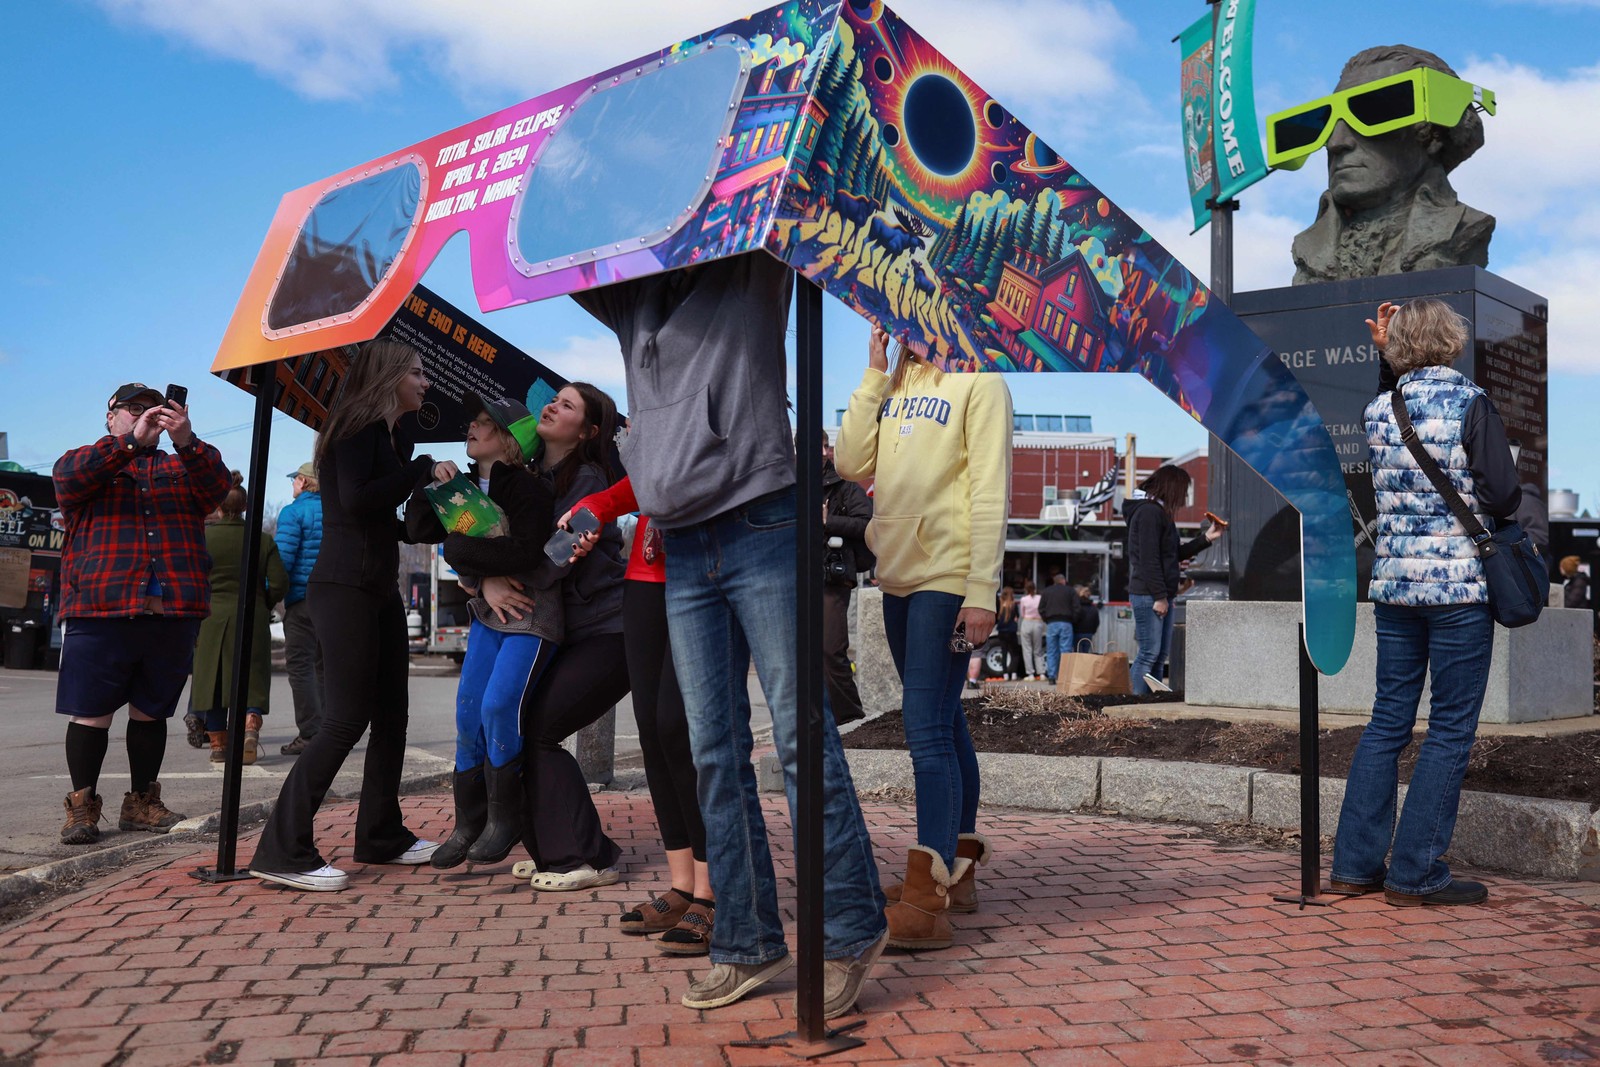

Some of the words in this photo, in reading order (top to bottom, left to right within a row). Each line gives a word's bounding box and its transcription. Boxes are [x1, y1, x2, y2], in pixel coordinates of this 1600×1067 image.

[435, 139, 471, 167] TOTAL
[470, 124, 512, 155] SOLAR
[510, 104, 564, 140] ECLIPSE
[441, 163, 476, 191] APRIL
[475, 158, 490, 180] 8,
[491, 144, 530, 175] 2024
[424, 188, 479, 223] HOULTON,
[480, 174, 524, 205] MAINE
[404, 294, 429, 319] THE
[428, 307, 452, 335] END
[453, 324, 468, 345] IS
[468, 334, 497, 364] HERE
[392, 326, 411, 342] totality
[410, 338, 428, 353] during
[427, 348, 437, 358] the
[436, 353, 448, 366] April
[453, 364, 467, 377] 2024
[465, 371, 478, 384] Total
[477, 379, 490, 392] Solar
[395, 317, 417, 336] Houlton,
[417, 331, 434, 346] Maine
[437, 344, 447, 354] the
[454, 356, 468, 368] place
[467, 363, 474, 372] in
[473, 367, 482, 378] the
[482, 372, 490, 382] US
[489, 377, 495, 385] to
[494, 381, 507, 393] view
[1281, 350, 1316, 368] RGE
[1325, 344, 1380, 365] WASH
[433, 381, 453, 397] Festival
[434, 362, 445, 373] this
[444, 369, 475, 392] astronomical
[438, 375, 448, 385] our
[447, 382, 465, 396] unique
[882, 396, 952, 426] APECOD
[1335, 442, 1359, 455] AND
[1341, 461, 1373, 474] RESI
[0, 520, 26, 535] EEL
[28, 534, 46, 548] ON
